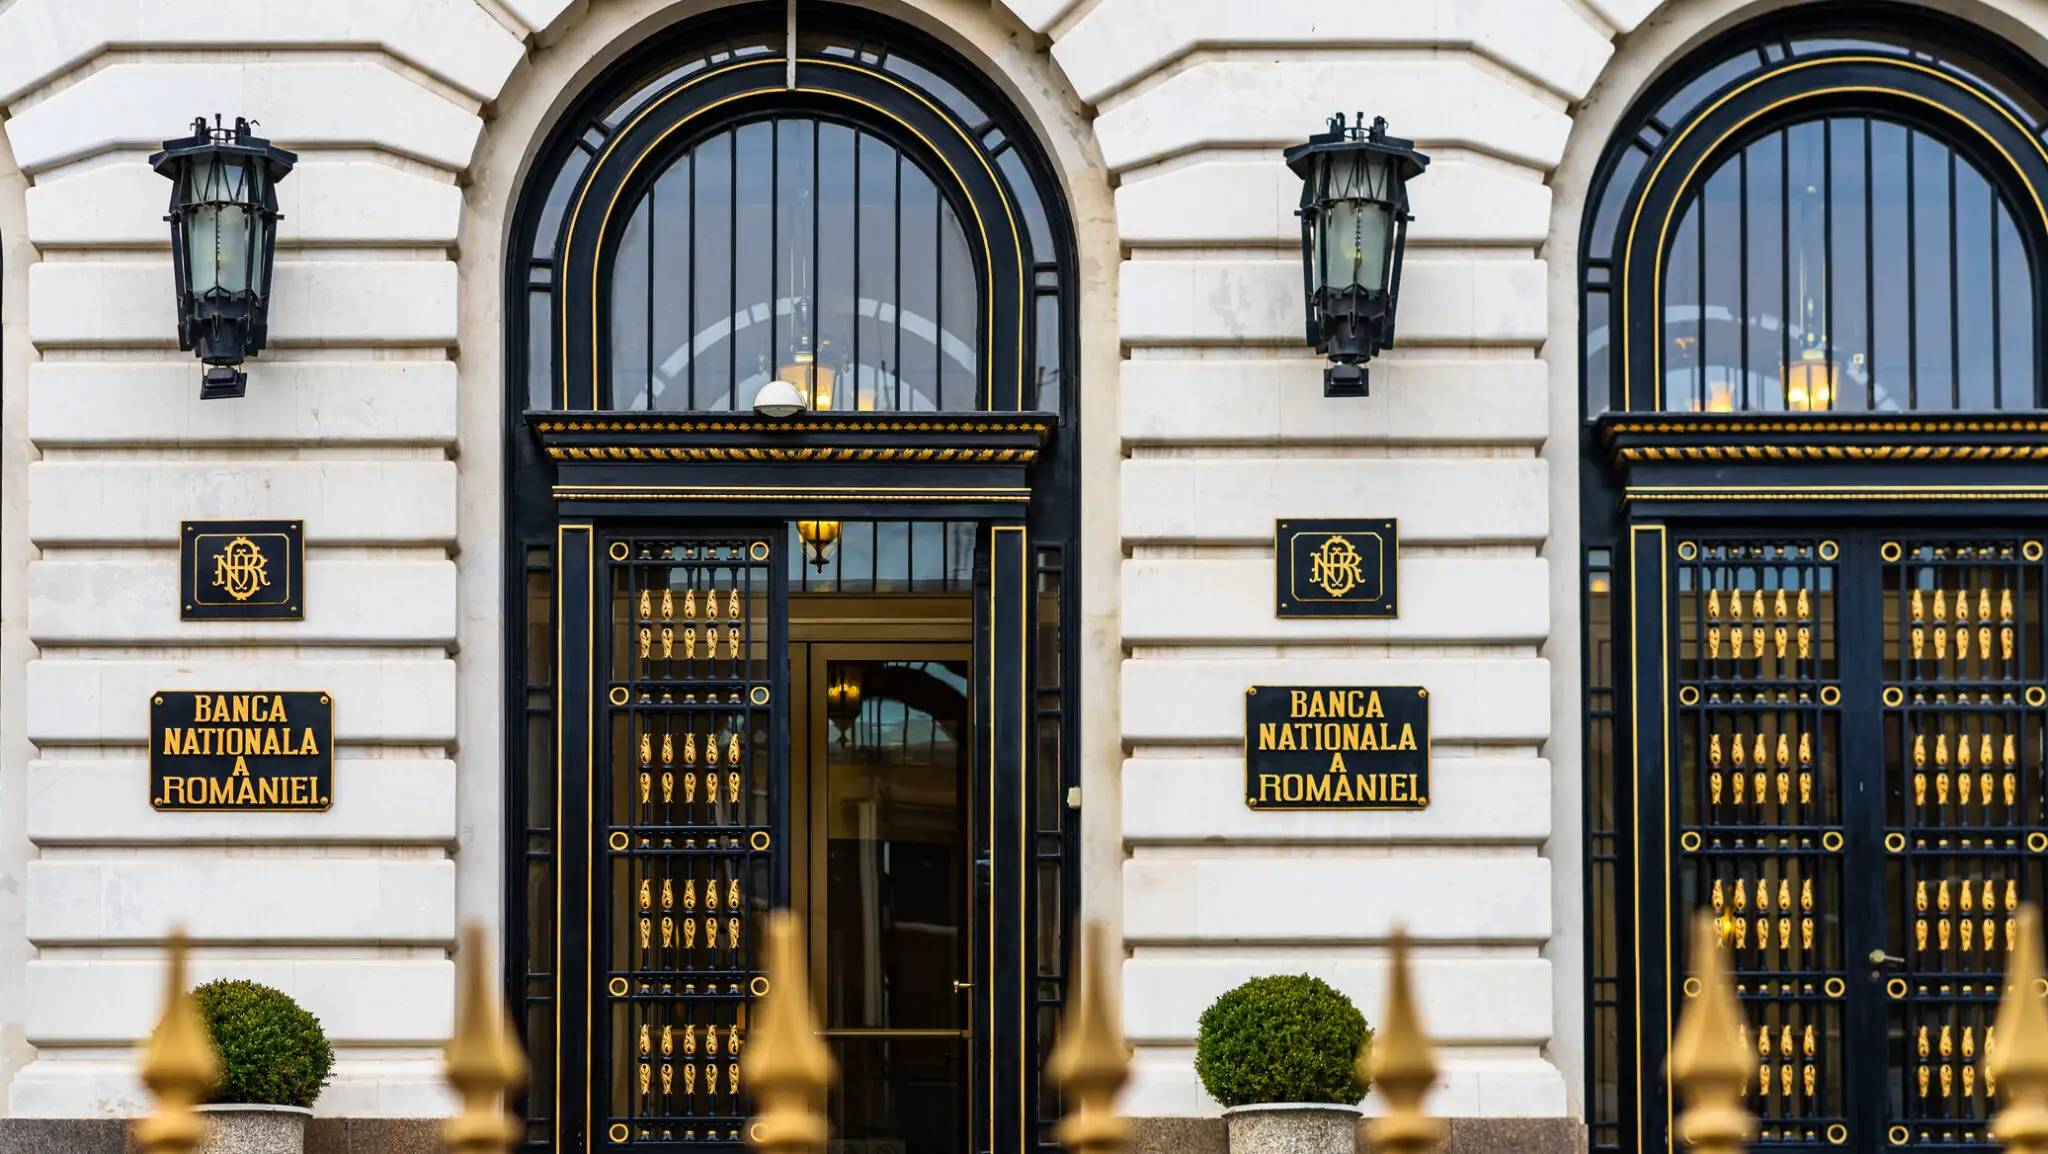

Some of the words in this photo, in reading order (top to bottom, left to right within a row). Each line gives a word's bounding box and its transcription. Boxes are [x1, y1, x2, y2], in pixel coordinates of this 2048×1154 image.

[194, 694, 288, 722] BANCA
[1290, 690, 1384, 718] BANCA
[163, 727, 319, 756] NATIONALA
[1258, 723, 1417, 751] NATIONALA
[232, 755, 250, 776] A
[1329, 752, 1347, 773] A
[162, 776, 319, 804] ROMANIEI
[1259, 774, 1418, 802] ROMANIEI
